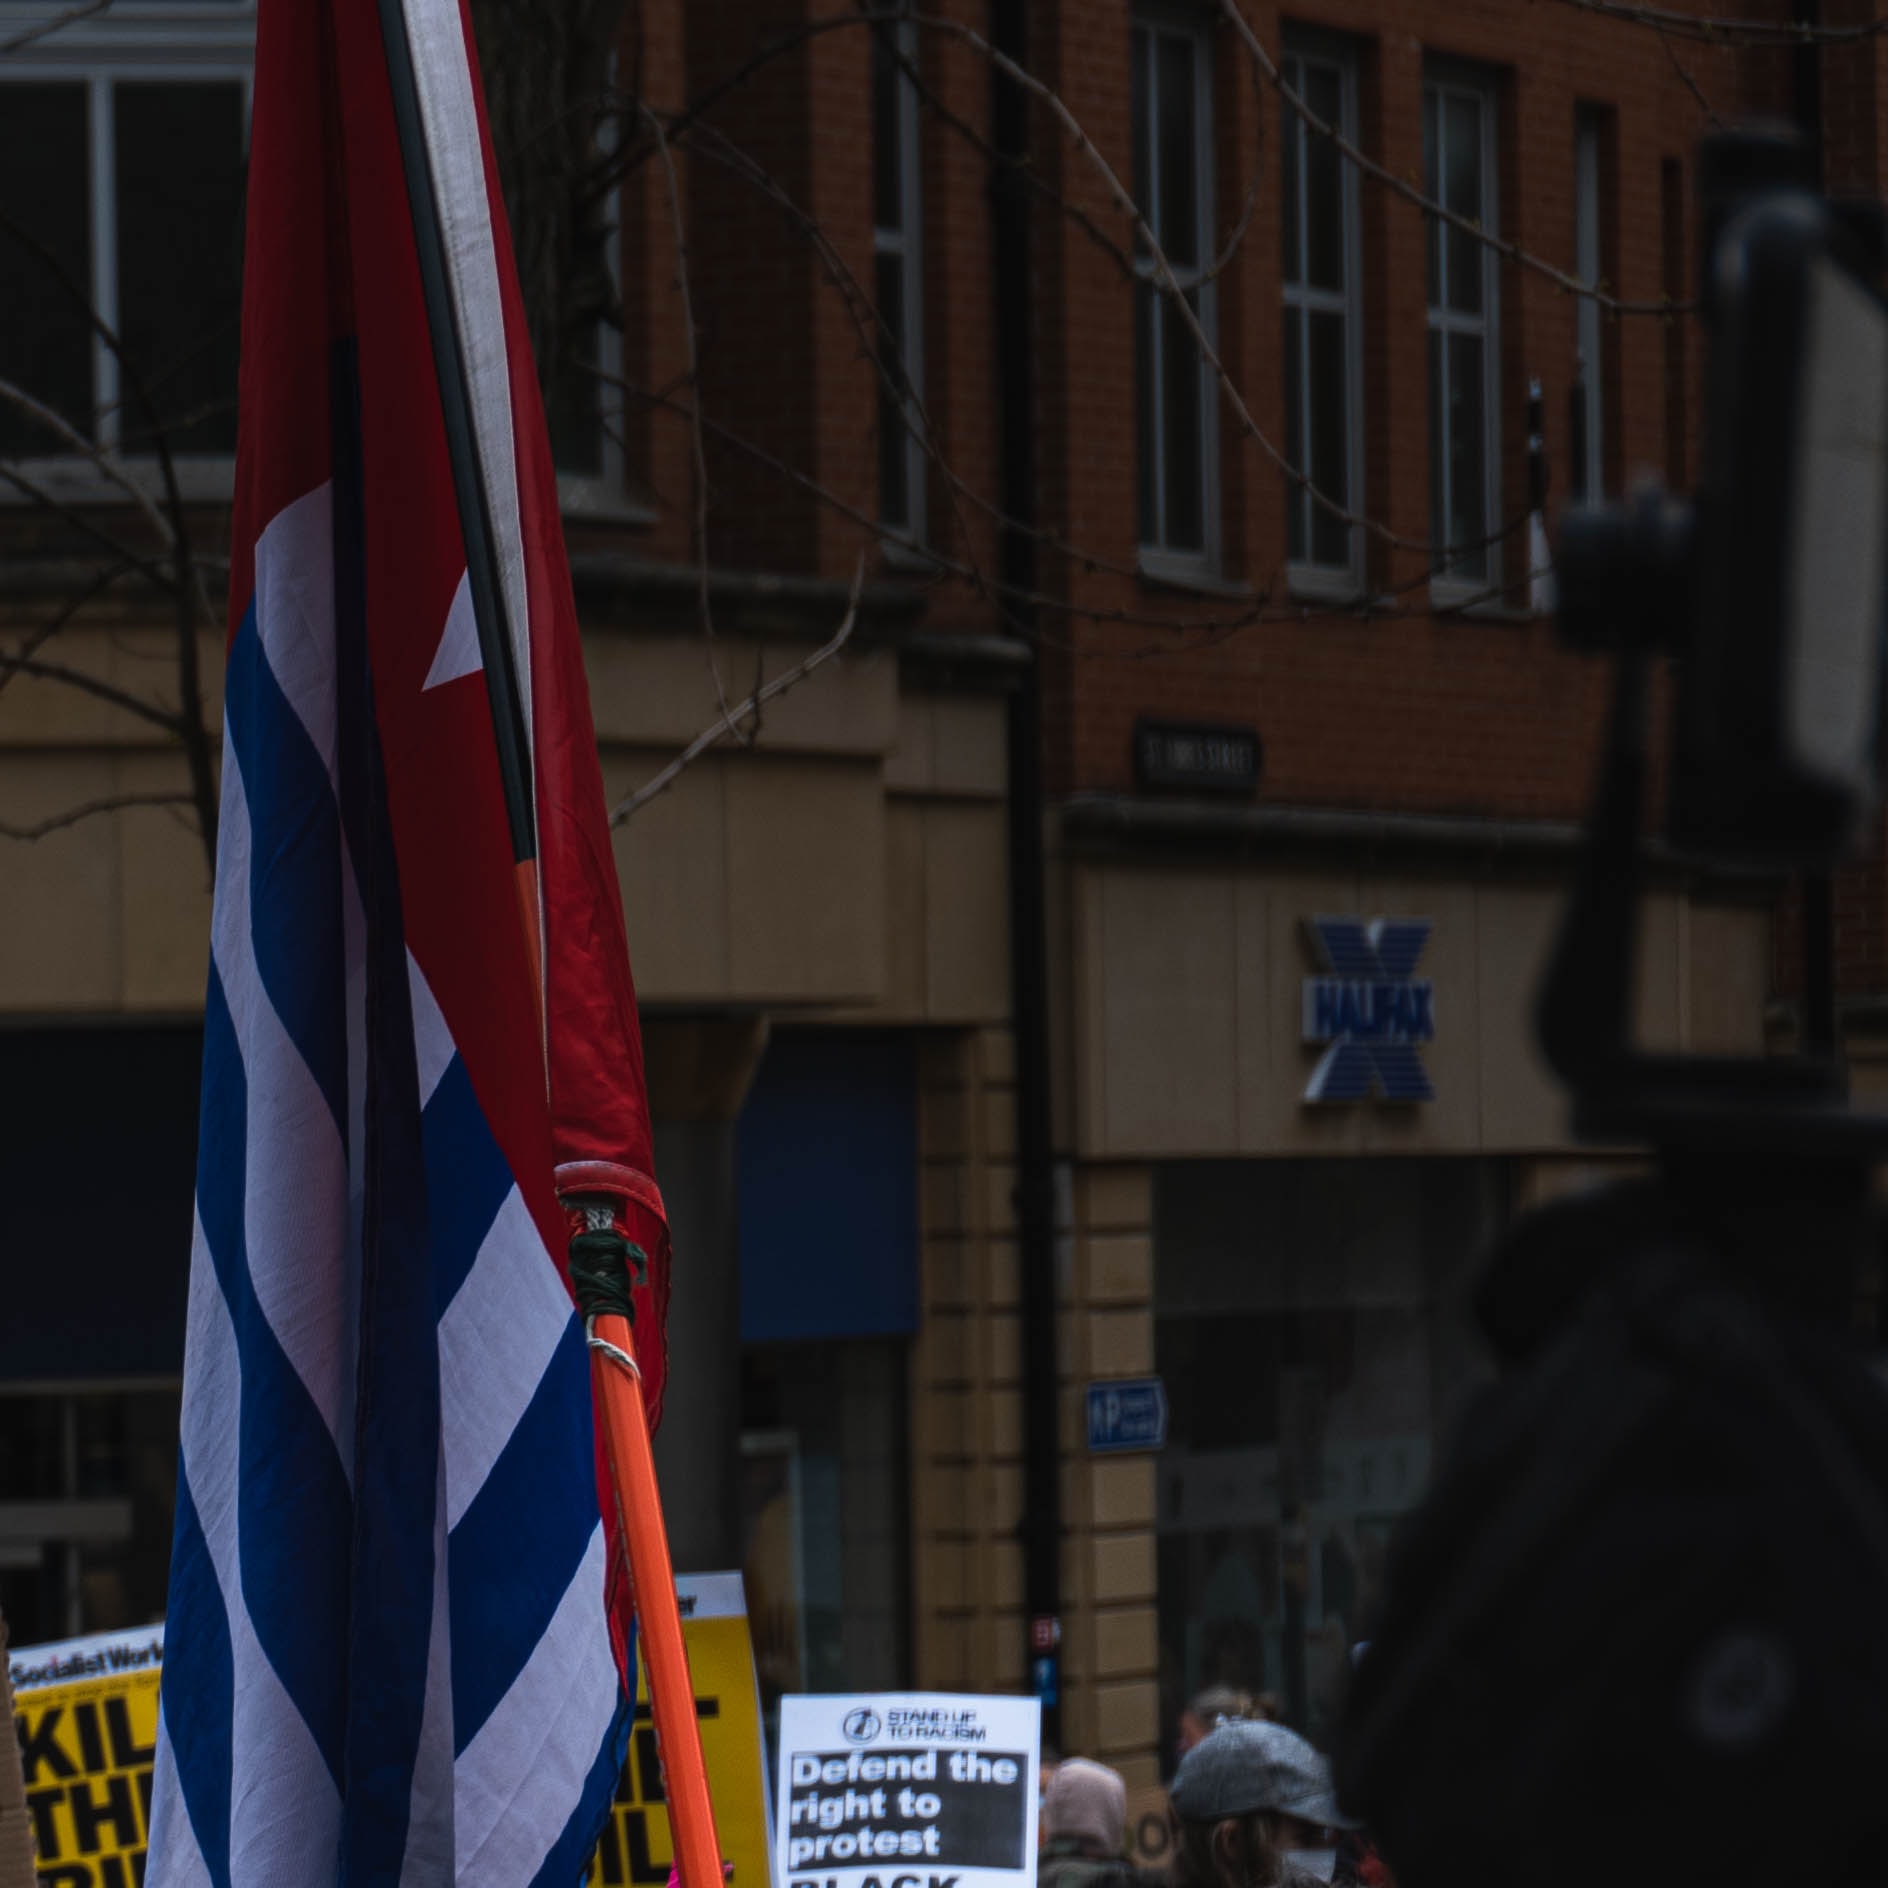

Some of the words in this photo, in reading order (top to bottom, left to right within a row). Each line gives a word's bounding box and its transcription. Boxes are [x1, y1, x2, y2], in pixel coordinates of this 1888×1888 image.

[1308, 979, 1435, 1040] HALIFAX
[108, 1638, 165, 1668] Work
[17, 1698, 155, 1785] KIL
[791, 1750, 938, 1787] Defend
[948, 1750, 1019, 1785] the
[790, 1786, 888, 1830] right
[897, 1786, 942, 1819] to
[789, 1824, 941, 1869] protest
